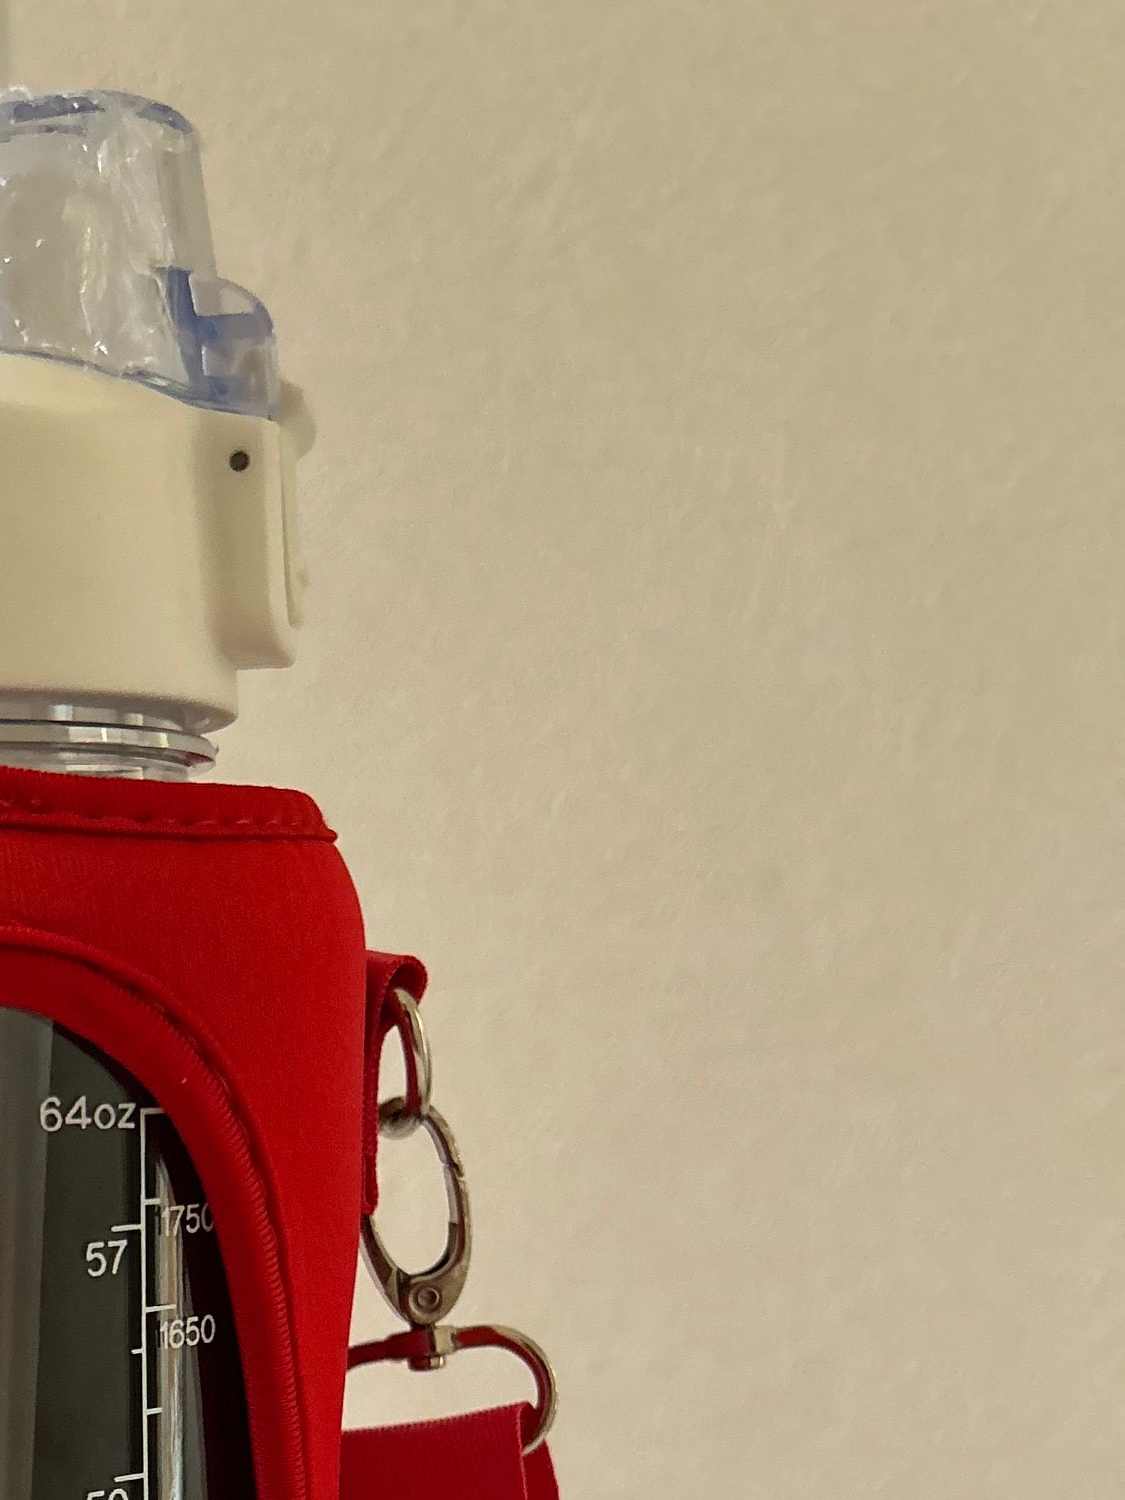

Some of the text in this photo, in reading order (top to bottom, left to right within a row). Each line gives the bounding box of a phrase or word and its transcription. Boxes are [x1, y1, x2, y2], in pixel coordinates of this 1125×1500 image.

[39, 1095, 136, 1132] 64oz
[85, 1239, 128, 1277] 57
[159, 1314, 216, 1349] 1650
